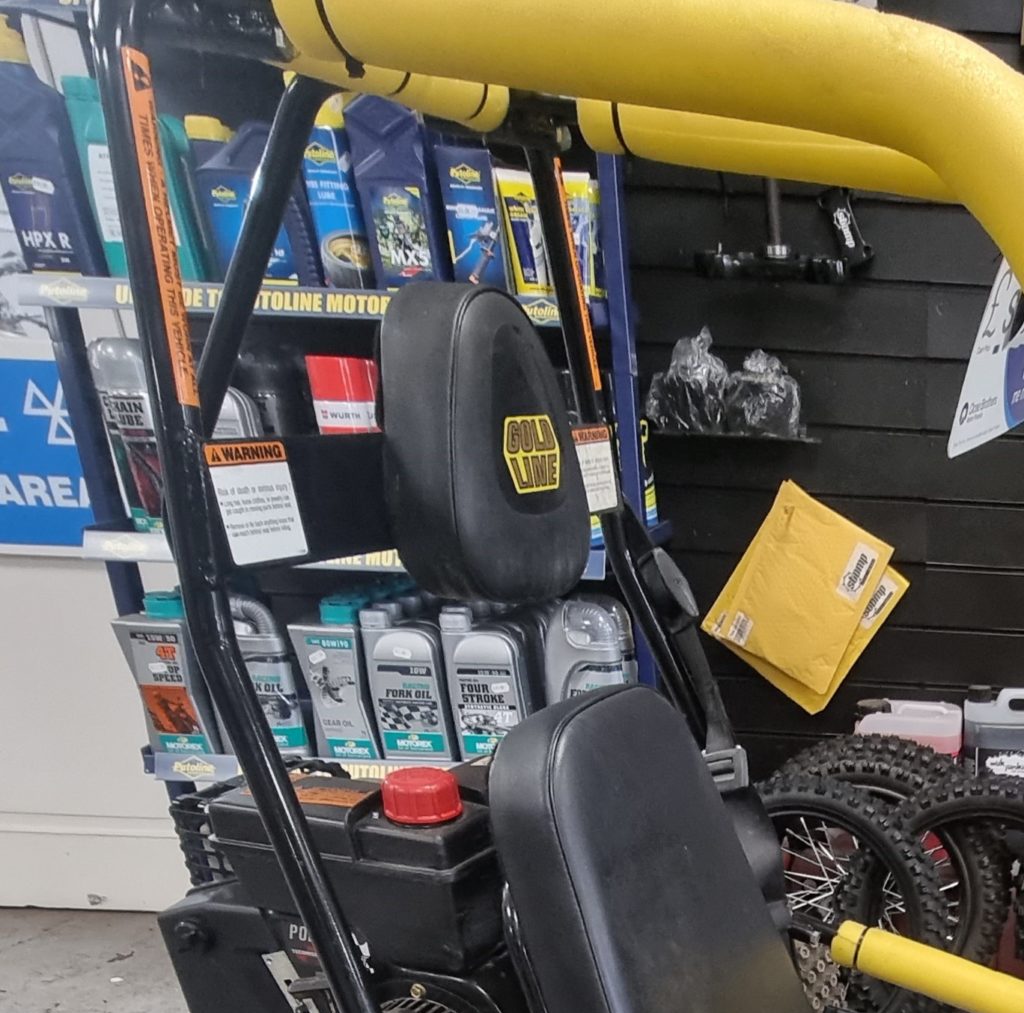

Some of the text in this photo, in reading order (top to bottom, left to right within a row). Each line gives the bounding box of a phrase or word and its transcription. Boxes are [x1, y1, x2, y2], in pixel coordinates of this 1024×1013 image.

[139, 114, 153, 157] TIMES
[146, 159, 160, 203] WHEN
[153, 204, 174, 285] OPERATING
[167, 287, 179, 317] THIS
[22, 230, 72, 249] HPX R
[253, 291, 322, 313] TOLINE
[506, 419, 556, 454] GOLD
[578, 429, 608, 440] WARNING
[221, 445, 283, 462] WARNING
[509, 454, 557, 489] LINE
[409, 667, 429, 675] 10W
[152, 673, 183, 682] SPEED
[460, 683, 490, 693] FOUR
[385, 688, 433, 700] FORK OIL
[462, 693, 506, 704] STROKE
[322, 718, 355, 728] GEAR OIL
[396, 737, 433, 748] MOTOREX
[333, 745, 370, 755] MOTOREX
